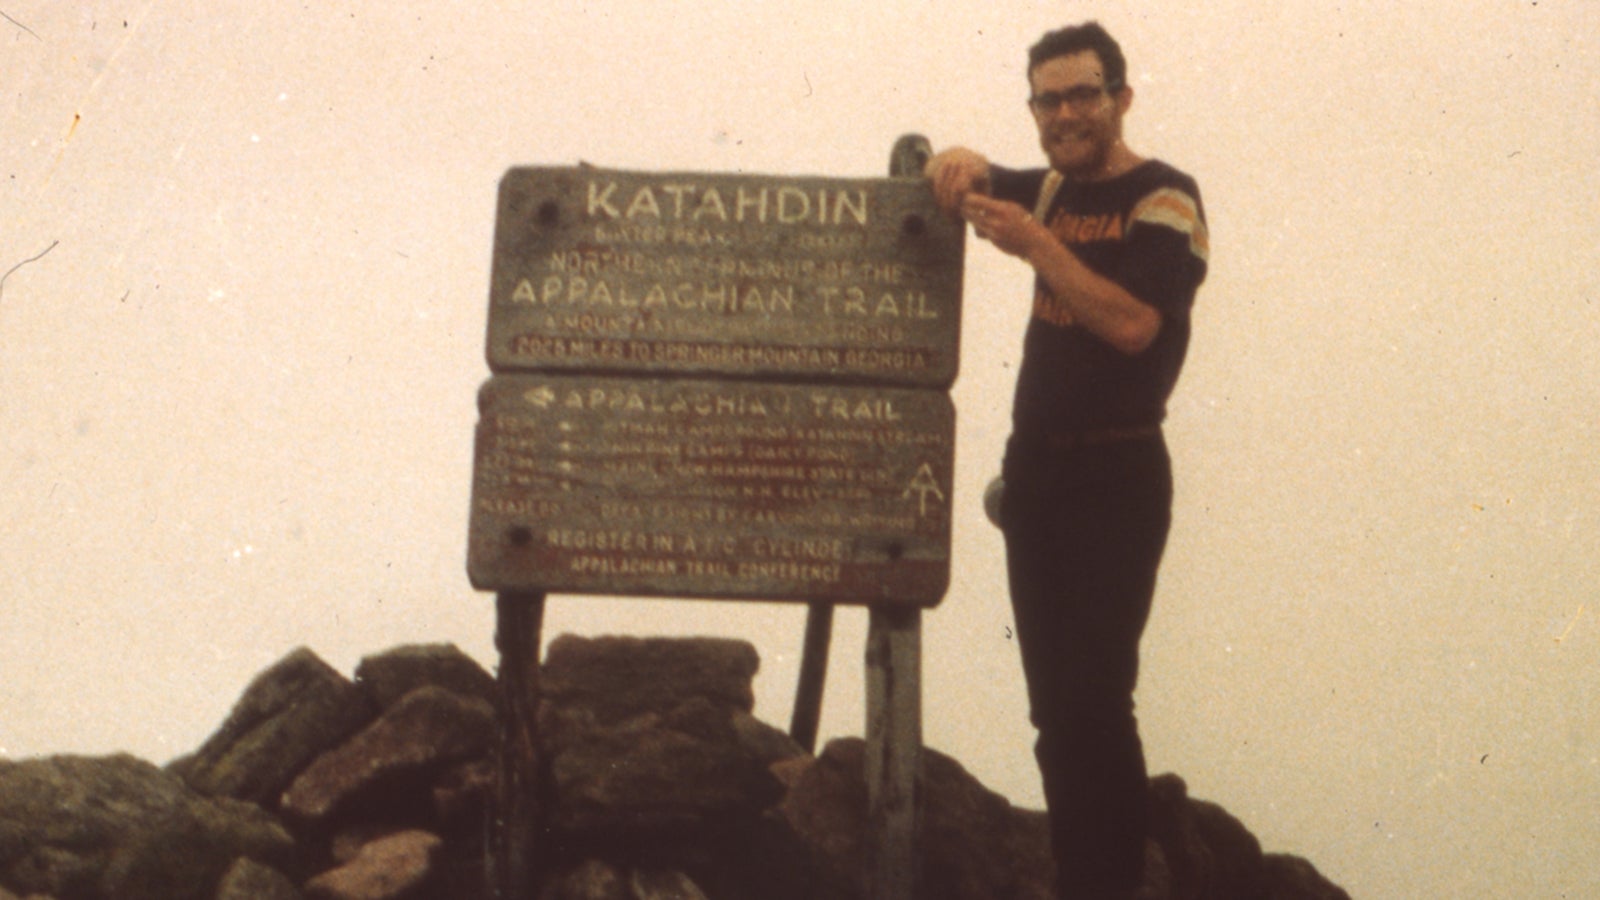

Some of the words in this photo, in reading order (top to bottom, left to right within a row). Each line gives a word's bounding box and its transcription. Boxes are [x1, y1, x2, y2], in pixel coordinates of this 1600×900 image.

[586, 180, 868, 225] KATAHDIN
[825, 259, 852, 280] OF
[861, 261, 903, 285] THE
[511, 276, 794, 313] APPALACHIAN
[817, 285, 938, 319] TRAIL
[569, 338, 626, 361] MILES
[630, 341, 652, 362] TO
[655, 342, 746, 366] SPRINGER
[748, 346, 840, 369] MOUNTAIN
[844, 350, 926, 371] GEORGIA
[811, 392, 899, 421] TRAIL
[546, 528, 648, 552] REGISTER
[653, 533, 674, 553] IN
[569, 555, 677, 575] APPALACHIAN
[686, 558, 731, 578] TRAIL
[736, 560, 841, 583] CONFERENCE
